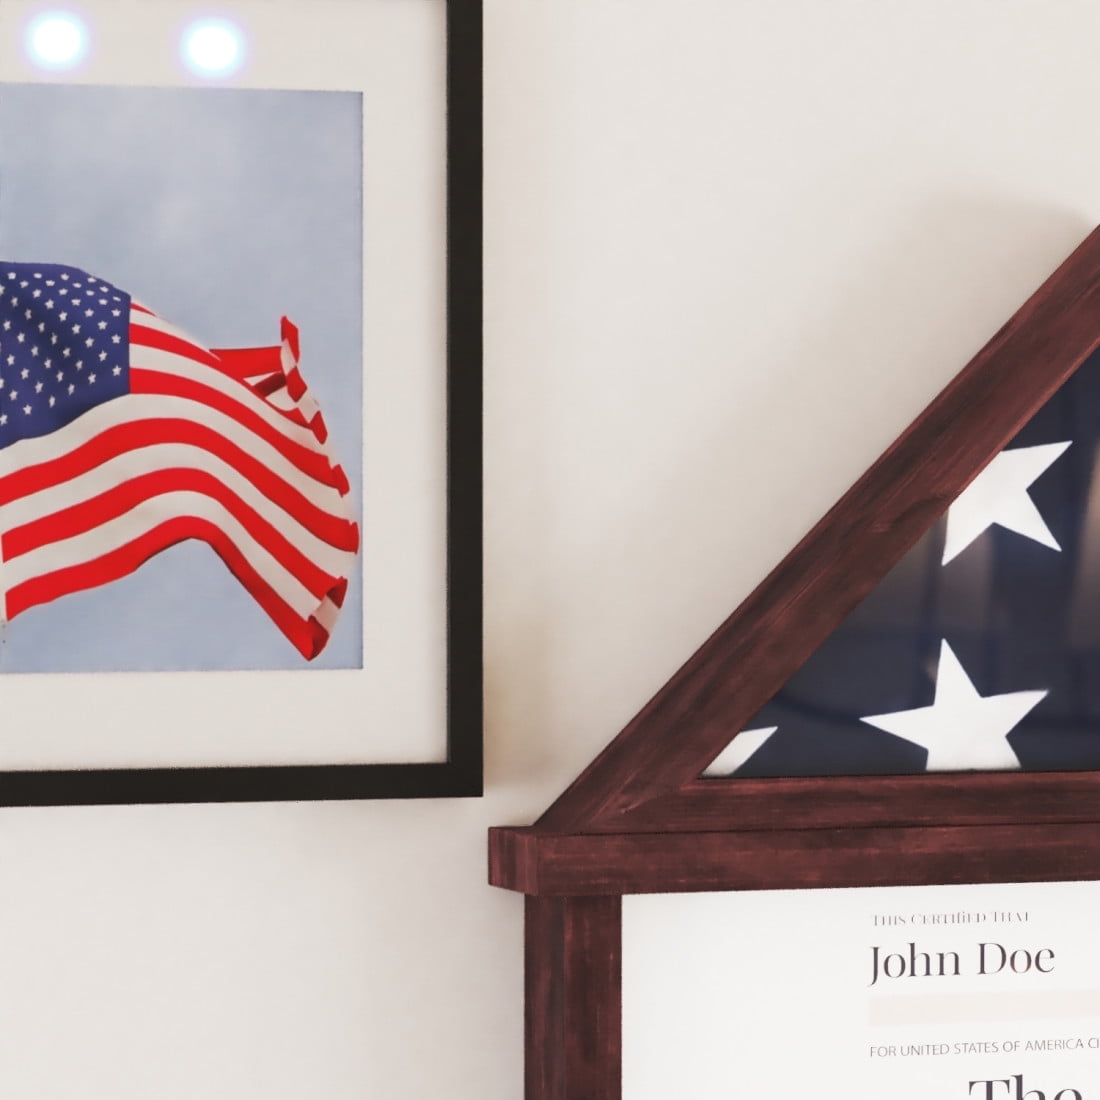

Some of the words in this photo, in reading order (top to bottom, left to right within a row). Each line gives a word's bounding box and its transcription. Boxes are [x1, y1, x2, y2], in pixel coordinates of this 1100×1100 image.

[872, 913, 907, 927] THIS
[992, 910, 1031, 924] THAT
[867, 942, 961, 987] John
[977, 942, 1056, 975] Doe
[869, 1045, 897, 1058] FOR
[900, 1043, 950, 1057] UNITED
[953, 1041, 1000, 1055] STATES
[1002, 1040, 1021, 1053] OF
[1024, 1038, 1085, 1051] AMERICA
